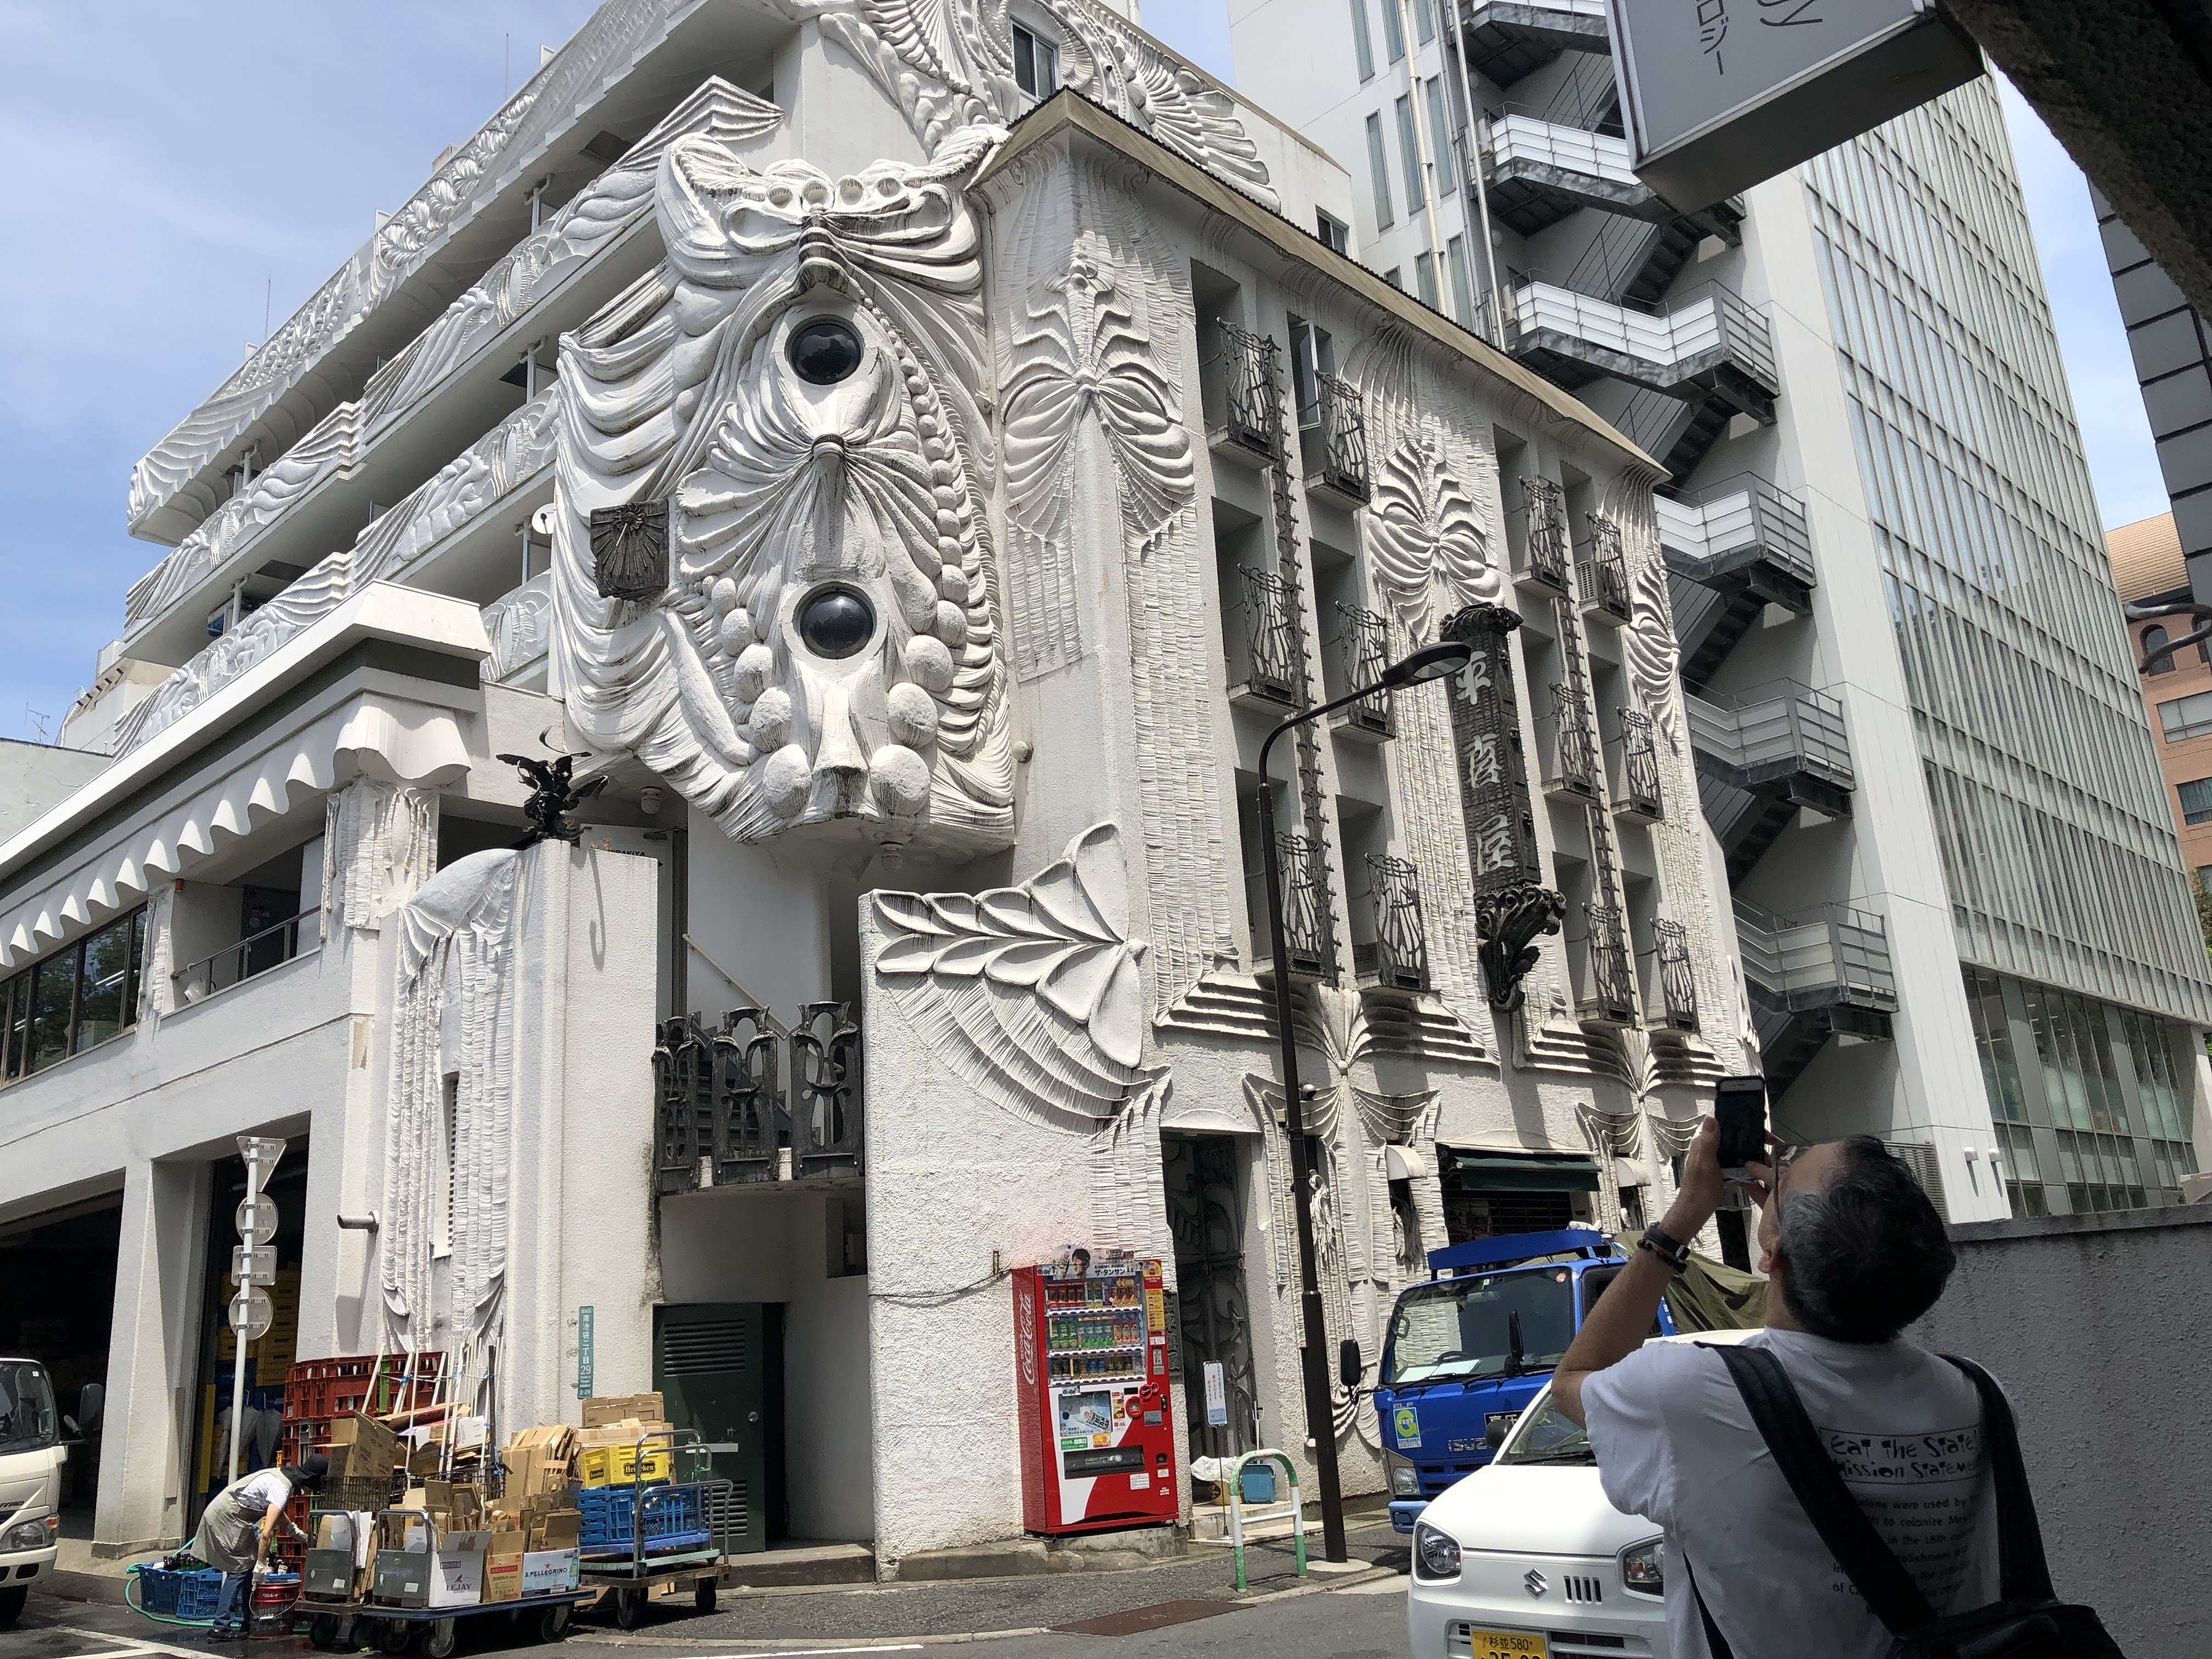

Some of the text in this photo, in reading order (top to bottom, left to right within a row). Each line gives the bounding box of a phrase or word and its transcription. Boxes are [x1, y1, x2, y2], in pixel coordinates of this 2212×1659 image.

[1696, 0, 1729, 75] ロジー
[1019, 1288, 1035, 1385] Coca-Cola
[580, 1365, 591, 1375] 29
[1448, 1437, 1490, 1452] ISUZ
[1831, 1435, 1871, 1458] Eat
[1881, 1438, 1917, 1459] The
[625, 1464, 654, 1473] Heieken
[1911, 1458, 1977, 1478] Stateme
[1893, 1500, 1918, 1509] were
[1923, 1498, 1949, 1509] used
[1954, 1497, 1966, 1510] by
[1884, 1517, 1894, 1526] to
[1900, 1516, 1943, 1527] colonize
[1903, 1536, 1919, 1544] the
[446, 1583, 472, 1592] LEJAY
[1833, 1582, 1844, 1593] of
